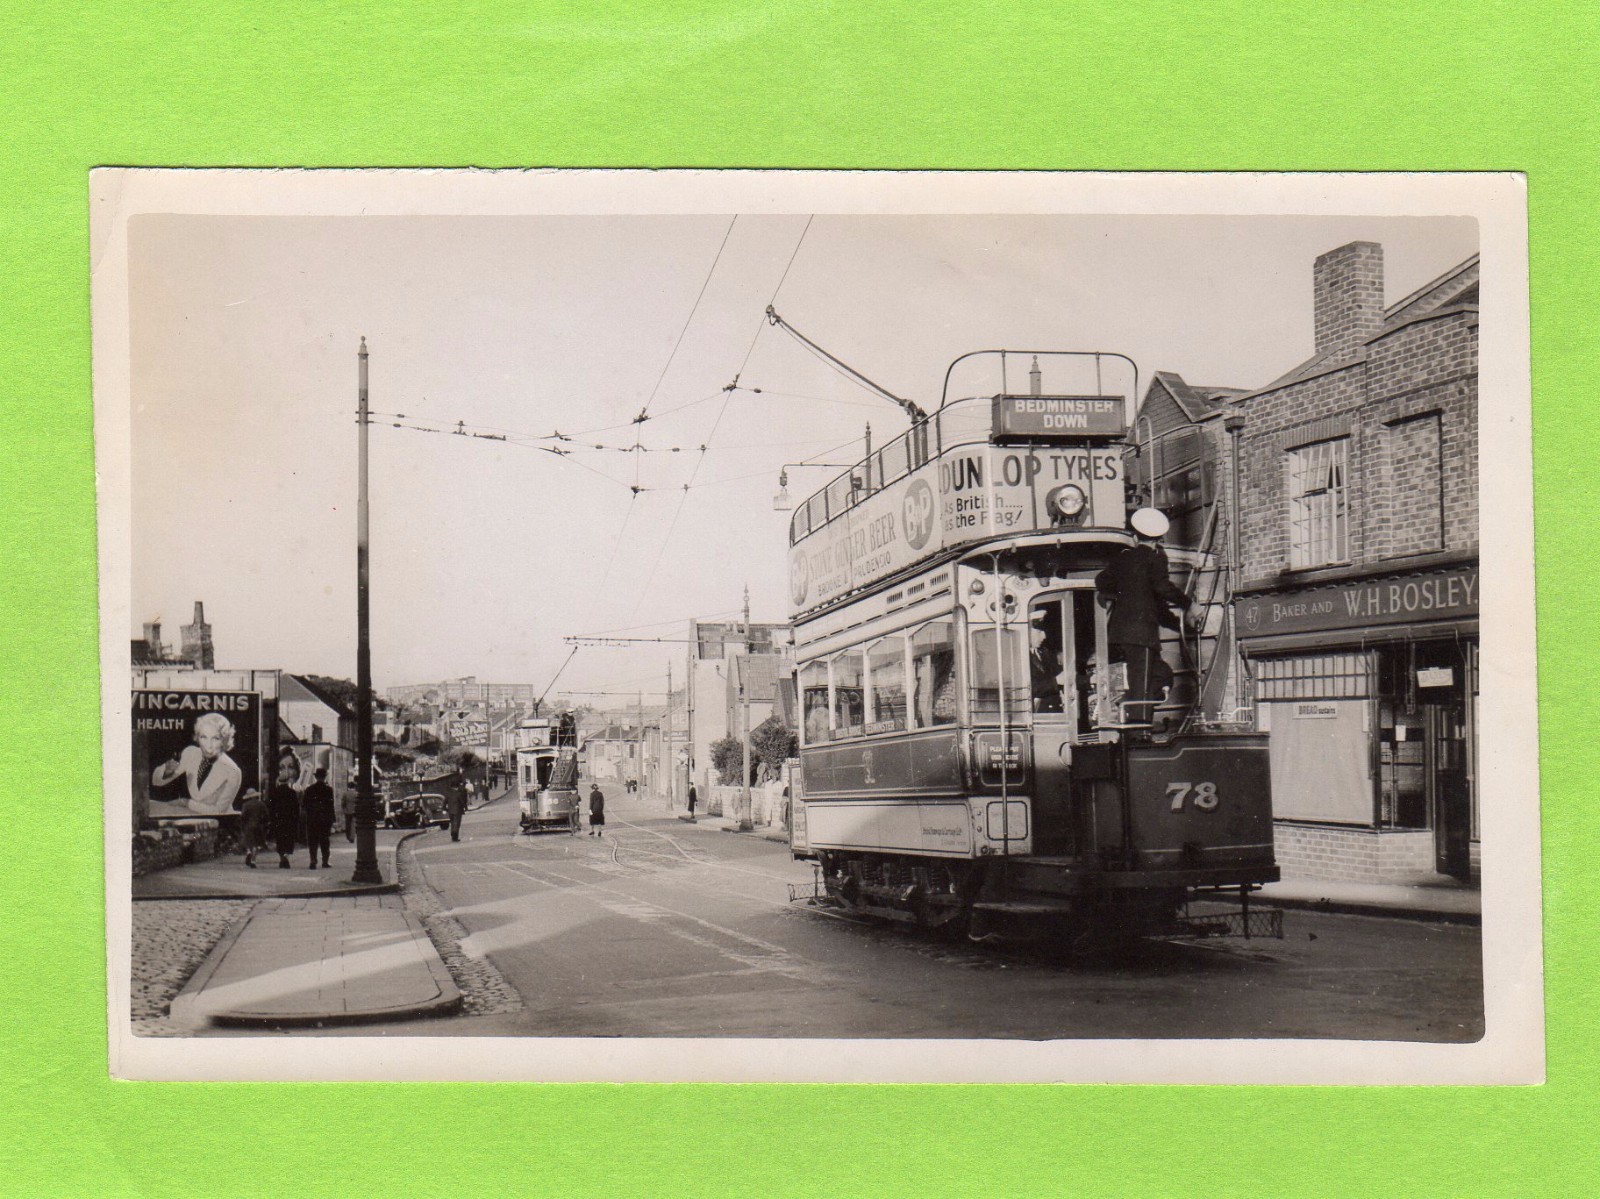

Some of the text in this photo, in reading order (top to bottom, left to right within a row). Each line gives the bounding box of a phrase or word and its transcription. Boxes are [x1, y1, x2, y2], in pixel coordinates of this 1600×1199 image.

[1014, 400, 1114, 413] BEDMINSTER
[1043, 414, 1088, 428] DOWN
[941, 454, 1118, 494] DUNLOP TYRES
[956, 512, 976, 528] the
[980, 509, 1023, 527] Fag!
[869, 512, 897, 552] BEER
[1246, 606, 1258, 623] 47
[1272, 603, 1308, 623] BAKER
[1311, 601, 1333, 614] AND
[137, 718, 185, 730] HEALTH
[1165, 782, 1219, 813] 78
